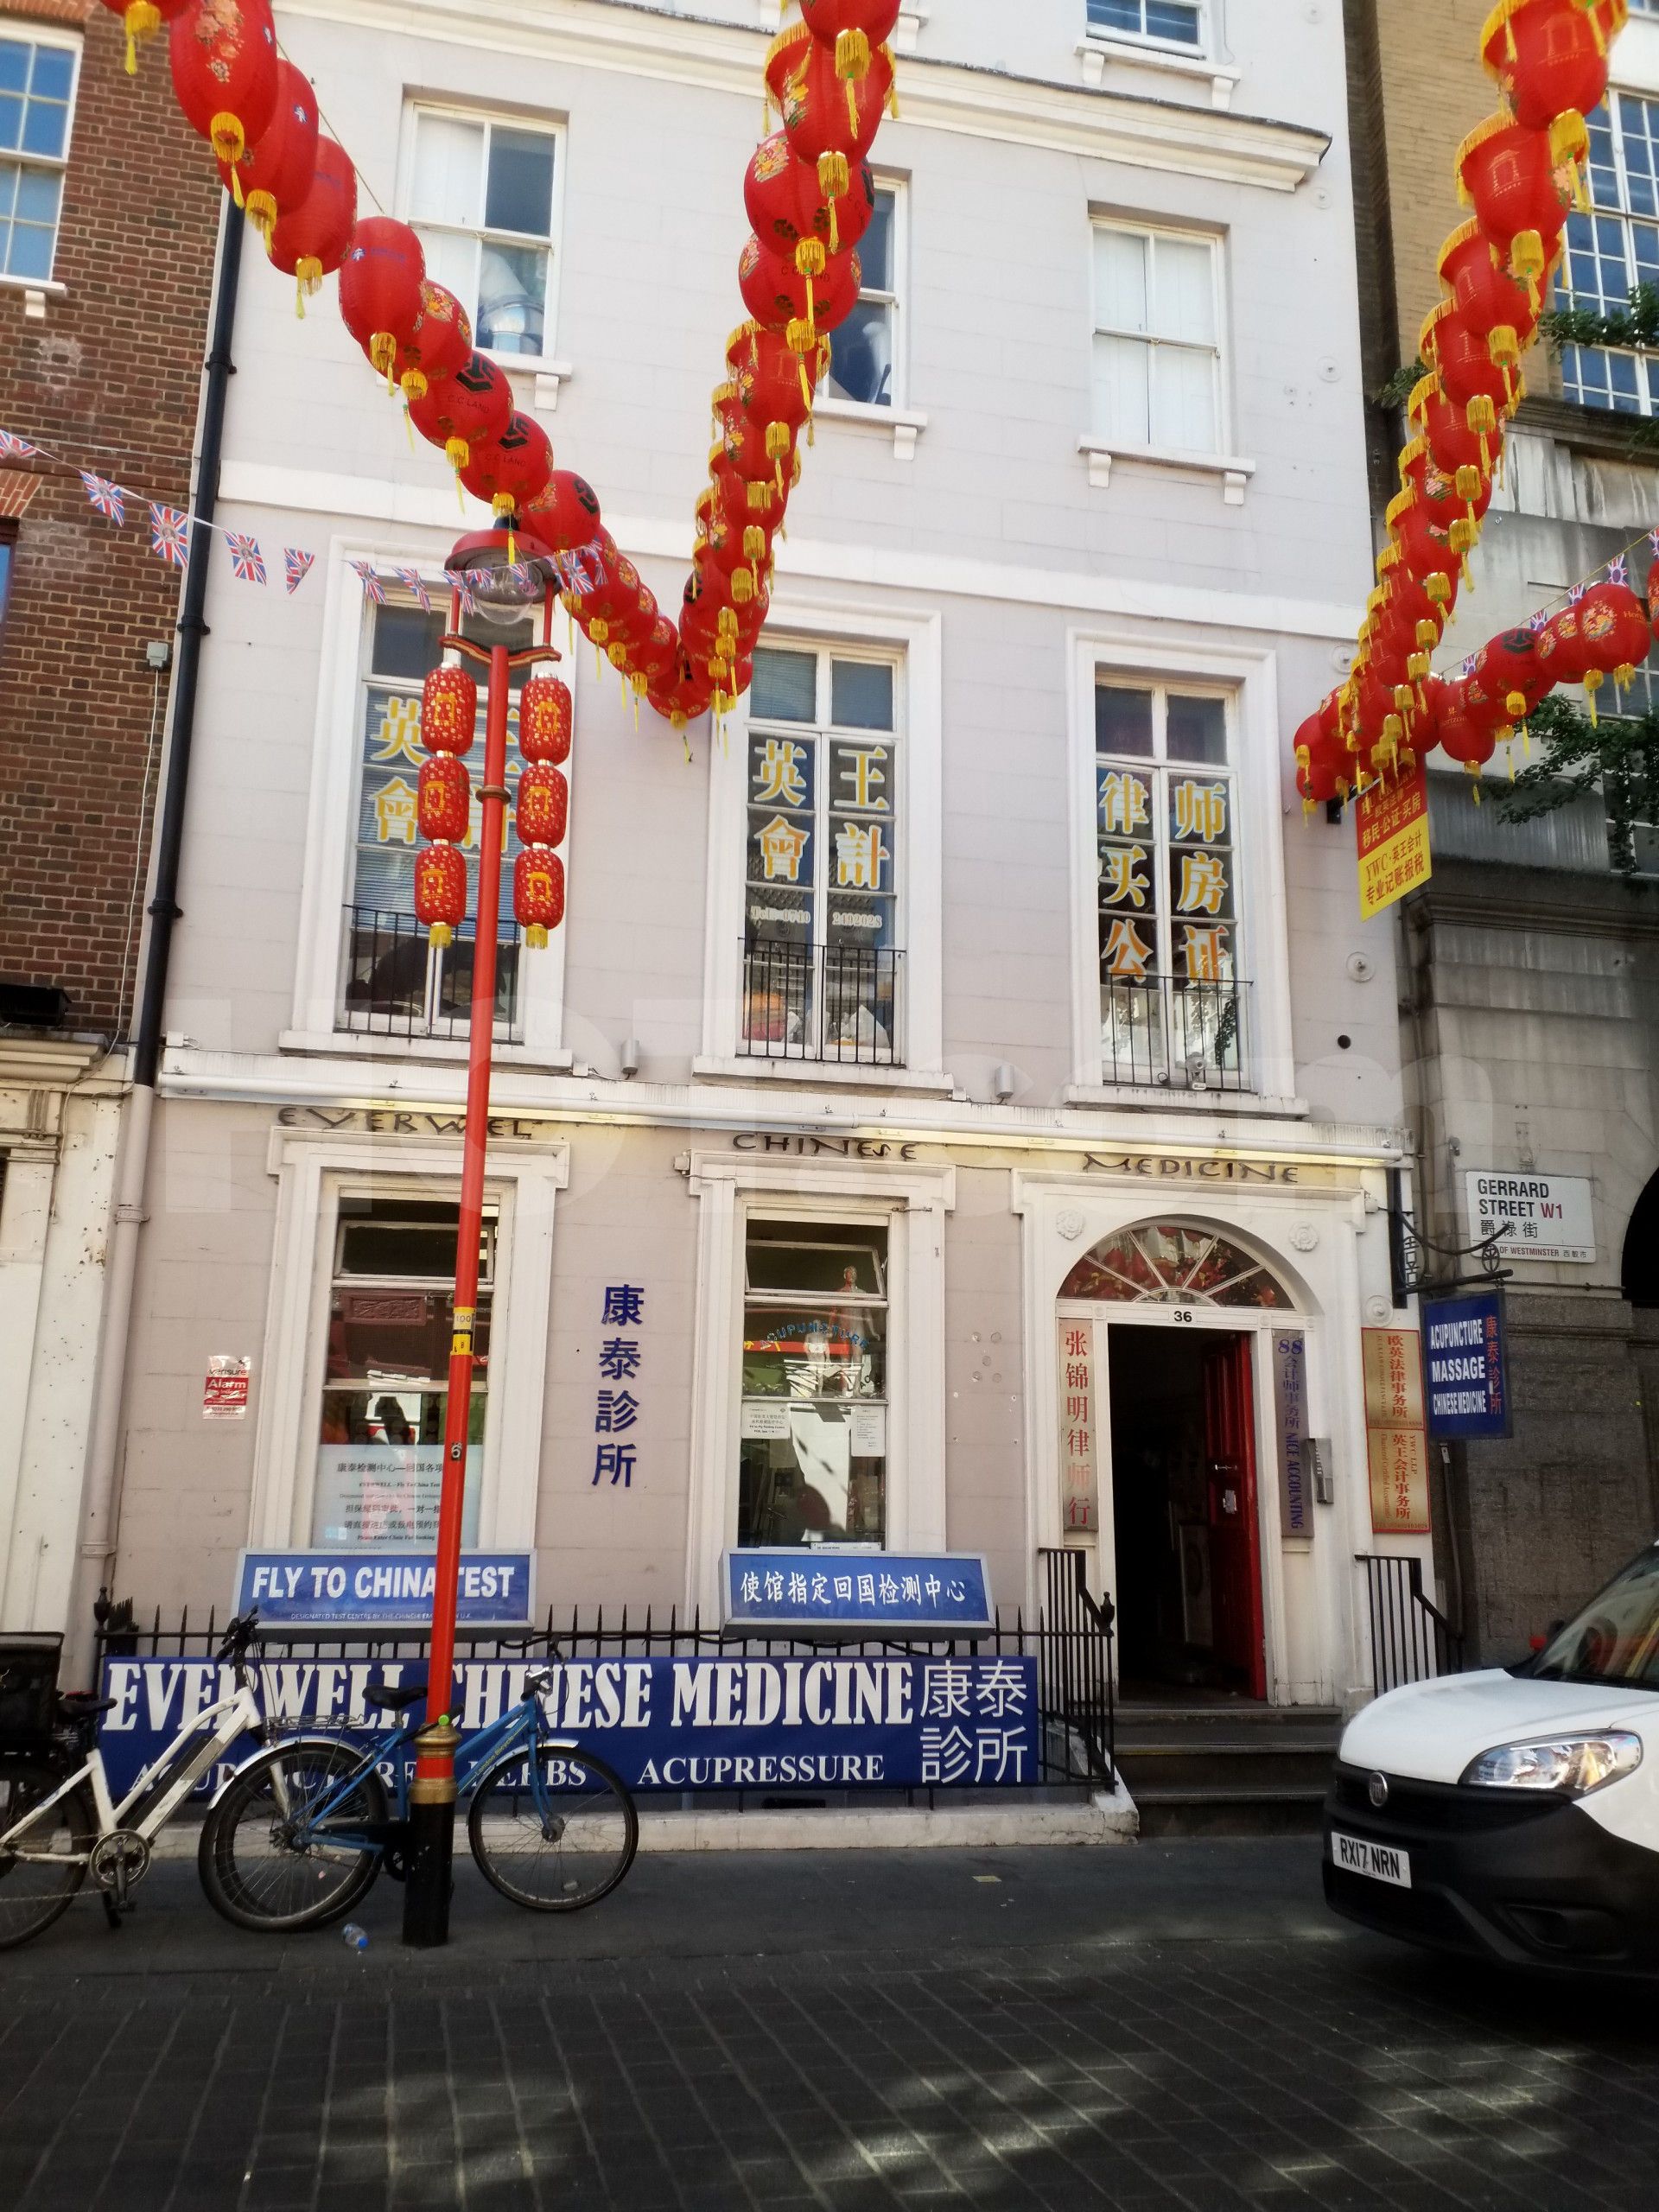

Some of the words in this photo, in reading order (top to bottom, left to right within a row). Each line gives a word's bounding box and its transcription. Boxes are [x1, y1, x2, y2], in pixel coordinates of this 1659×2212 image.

[1083, 1153, 1299, 1183] MEDICINE
[1478, 1179, 1549, 1198] GERRARD
[1478, 1199, 1535, 1217] STREET
[1541, 1202, 1563, 1219] W1
[1510, 1247, 1560, 1257] WESTMINSTER
[1173, 1310, 1193, 1324] 36
[1278, 1338, 1304, 1355] 88
[1430, 1319, 1484, 1350] ACUPUNCTURE
[207, 1378, 246, 1389] Alarm
[1432, 1356, 1486, 1382] MASSAGE
[591, 1282, 645, 1488] 康泰診所
[1433, 1392, 1459, 1415] CHINESE
[1459, 1390, 1487, 1414] MEDICINE
[1065, 1329, 1091, 1526] 张锦明律师行
[1285, 1432, 1300, 1457] NICE
[1286, 1460, 1305, 1529] ACCOUNTING
[251, 1567, 304, 1599] FLY
[310, 1567, 347, 1599] TO
[741, 1571, 966, 1608] 使馆指定回国检测中心
[671, 1661, 913, 1727] MEDICINE
[919, 1659, 1028, 1718] 康泰
[637, 1754, 886, 1785] ACUPRESSURE
[919, 1726, 1028, 1784] 診所
[1339, 1837, 1367, 1869] RX17
[1370, 1846, 1401, 1879] NRN
